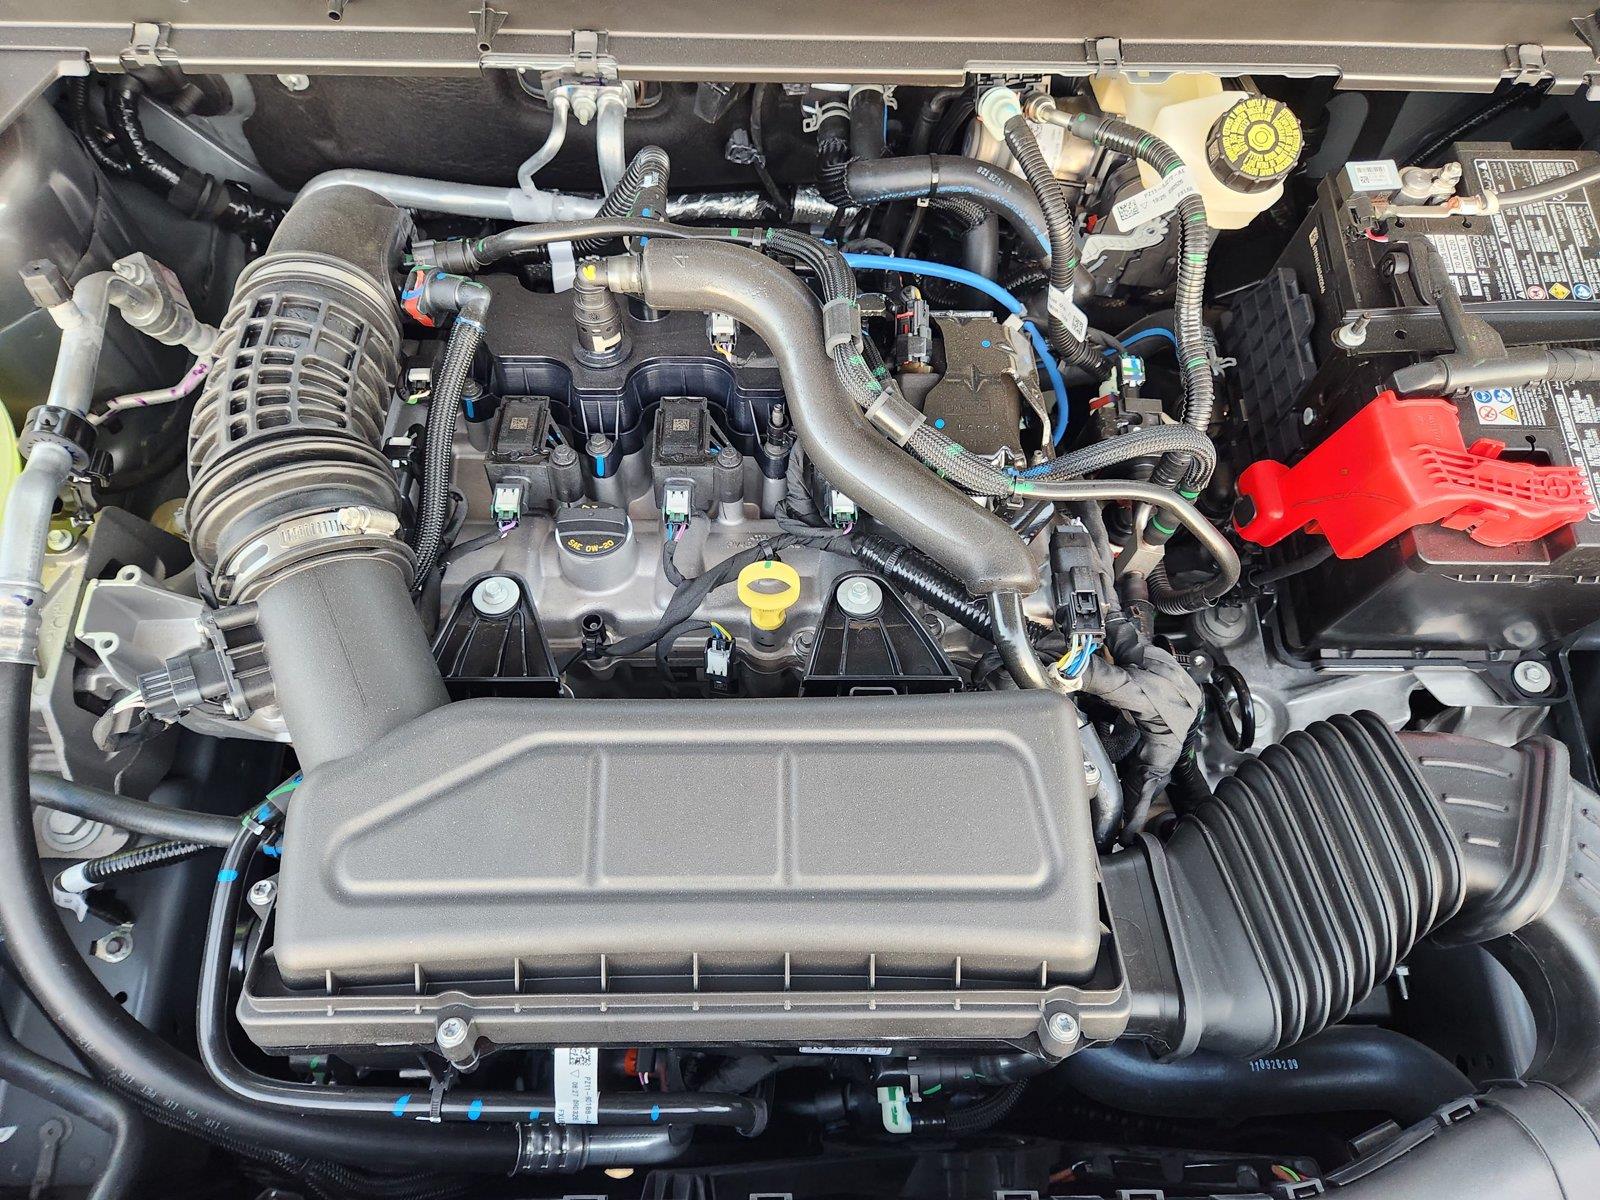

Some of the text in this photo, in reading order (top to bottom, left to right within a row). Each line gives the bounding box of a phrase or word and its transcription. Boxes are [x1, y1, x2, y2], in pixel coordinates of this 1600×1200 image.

[1471, 236, 1486, 267] FoMoCo
[568, 540, 614, 552] SAE 0W-20
